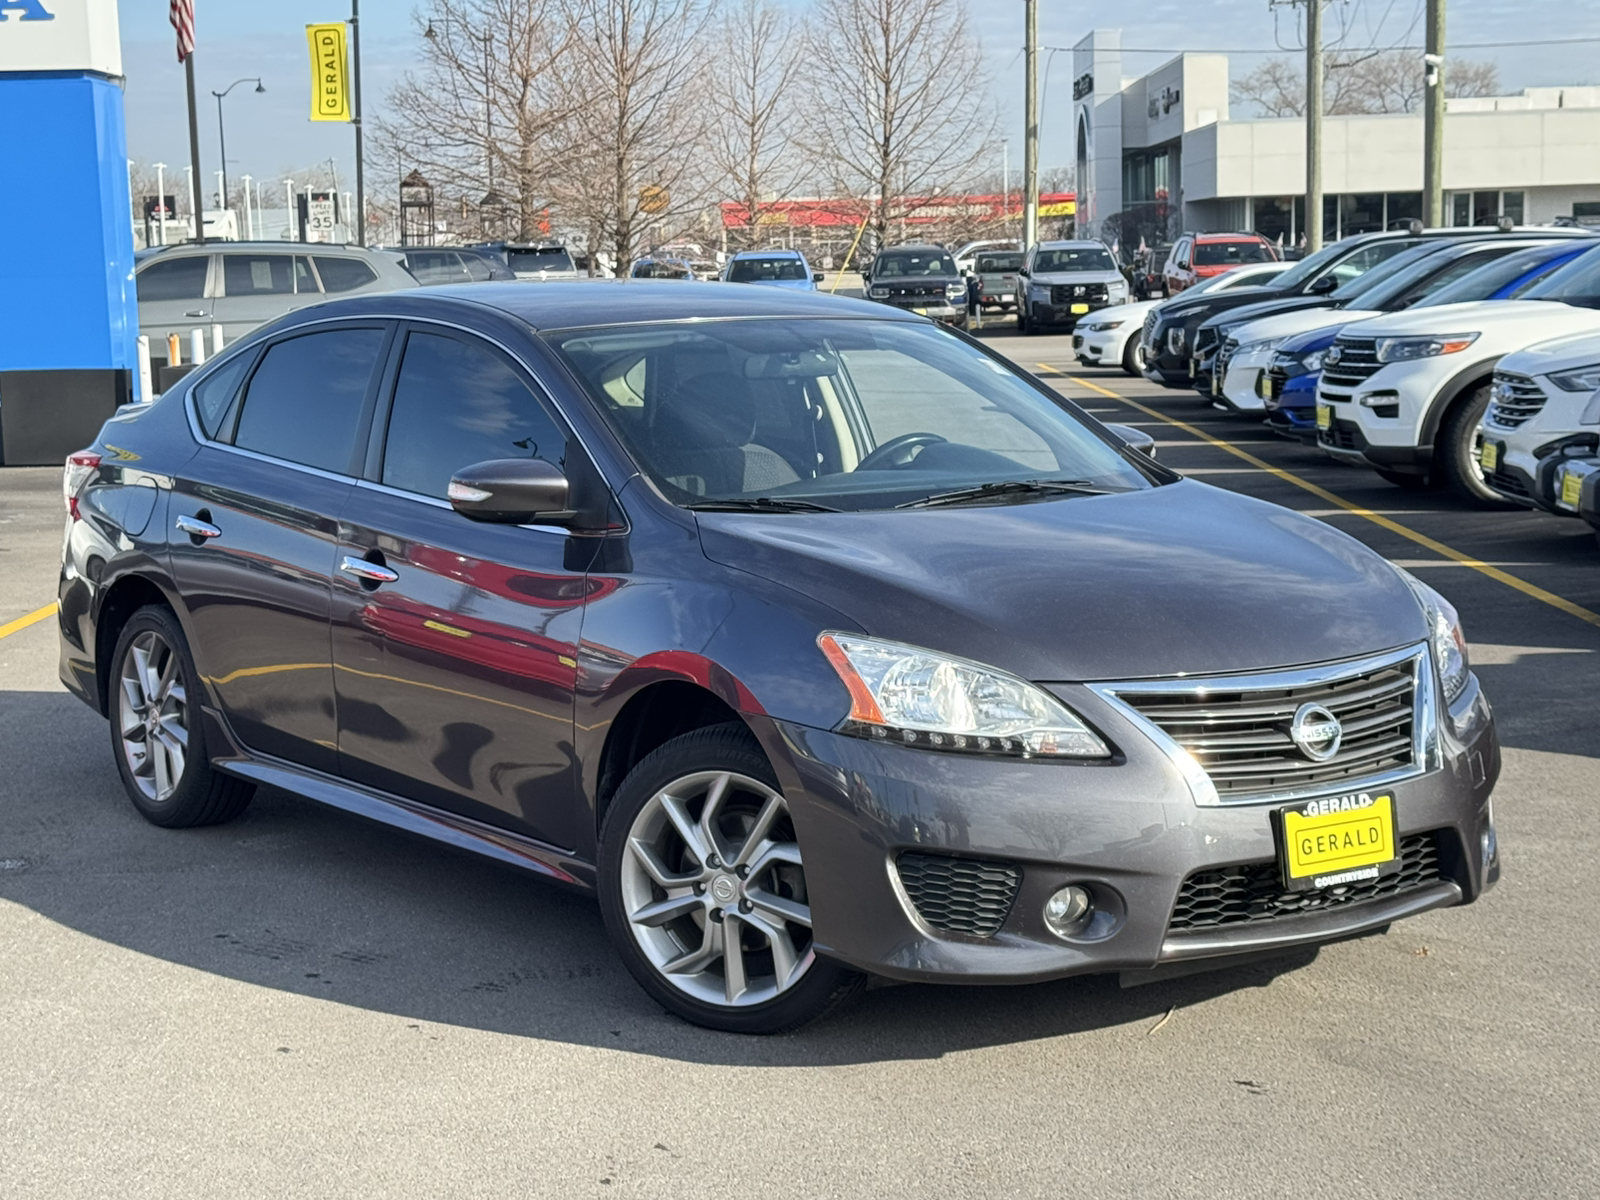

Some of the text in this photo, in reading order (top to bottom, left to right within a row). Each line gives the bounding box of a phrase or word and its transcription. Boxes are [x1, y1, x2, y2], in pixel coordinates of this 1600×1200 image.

[322, 36, 338, 108] GERALD
[312, 216, 332, 228] 35
[1301, 827, 1379, 856] GERALD
[1314, 867, 1380, 888] COUNTRYSIDE
